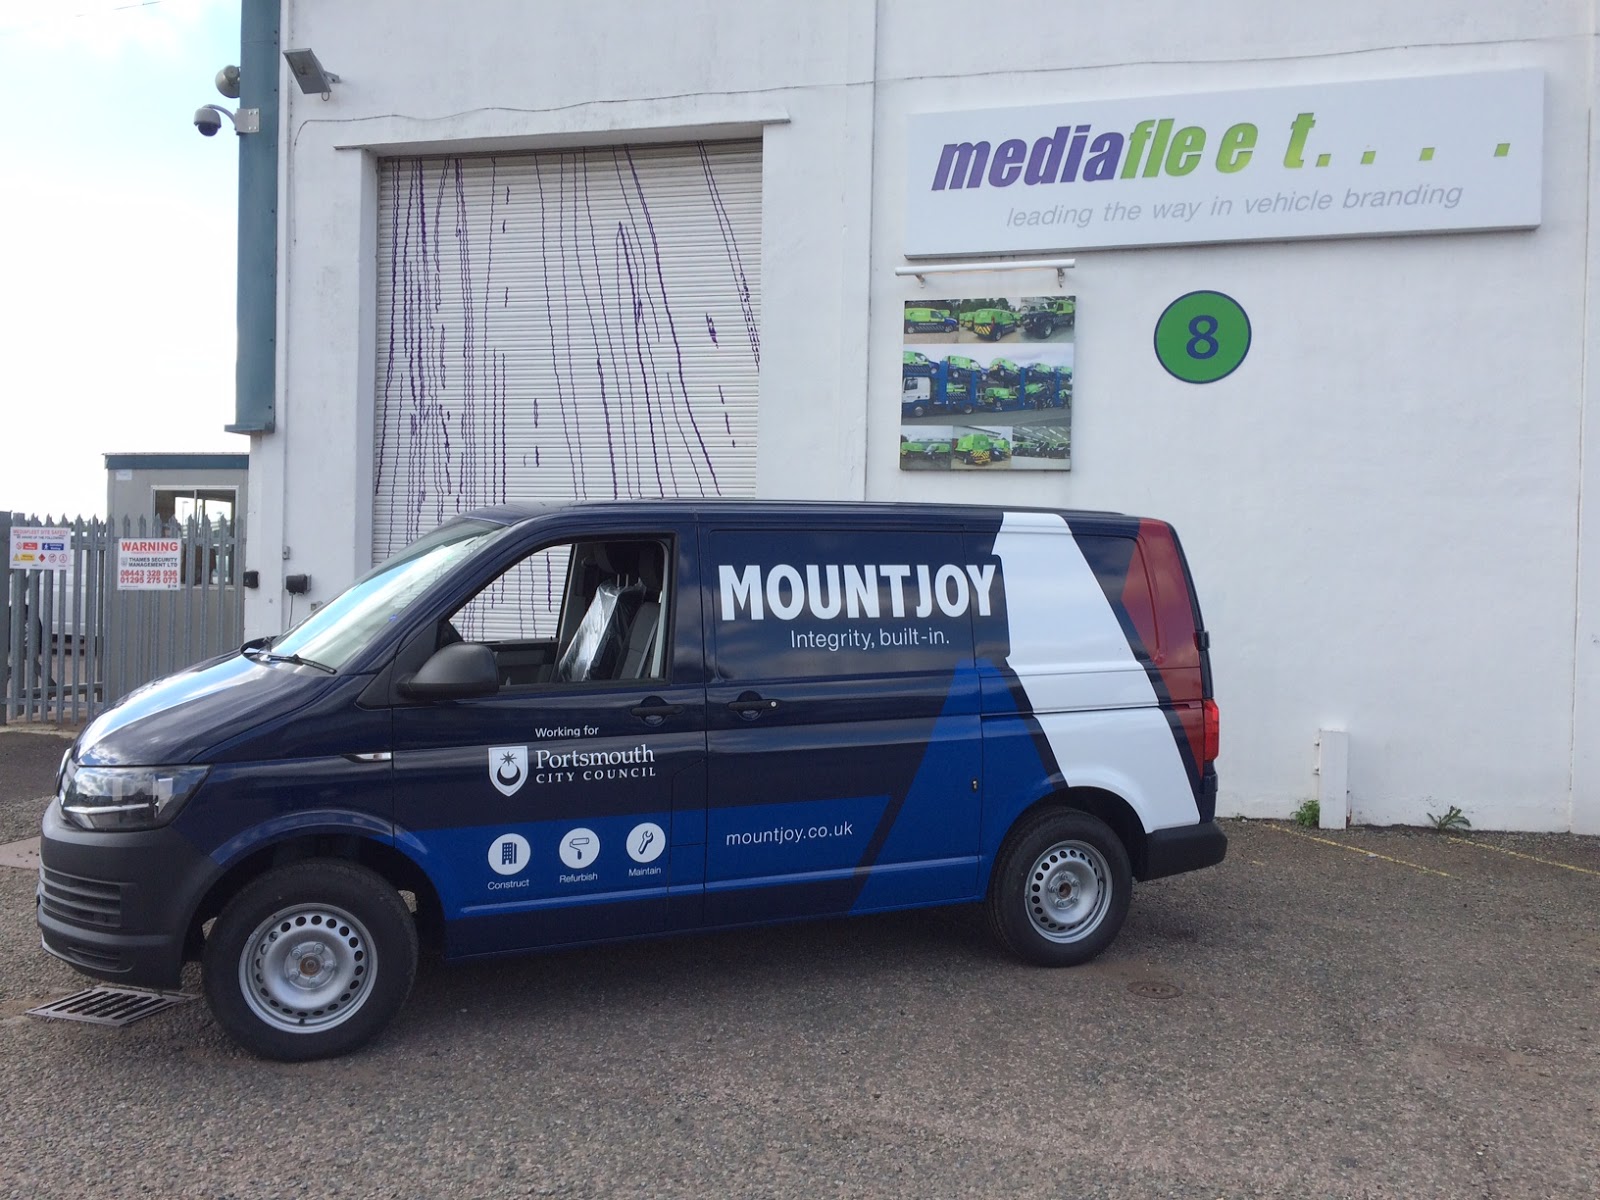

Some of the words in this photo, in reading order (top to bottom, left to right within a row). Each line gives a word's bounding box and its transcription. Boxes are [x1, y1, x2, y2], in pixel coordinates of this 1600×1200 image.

[1006, 206, 1093, 228] leading
[1103, 202, 1142, 222] the
[1152, 202, 1202, 222] way
[1210, 196, 1232, 216] in
[1245, 190, 1333, 214] vehicle
[1342, 184, 1463, 209] branding
[1186, 314, 1219, 359] 8
[121, 541, 178, 552] WARNING
[120, 576, 145, 584] 01295
[146, 576, 161, 584] 275
[162, 576, 178, 584] 073
[718, 563, 997, 621] MOUNTJOY
[790, 629, 875, 651] Integrity,
[880, 628, 950, 646] built-in.
[535, 727, 581, 738] Working
[583, 725, 599, 736] for
[535, 743, 655, 770] Portsmouth
[536, 772, 575, 784] CITY
[583, 767, 656, 781] COUNCIL
[726, 821, 853, 845] mountjoy.co.uk
[559, 872, 598, 883] Refurbish
[629, 866, 662, 876] Maintain
[487, 879, 530, 890] Construct
